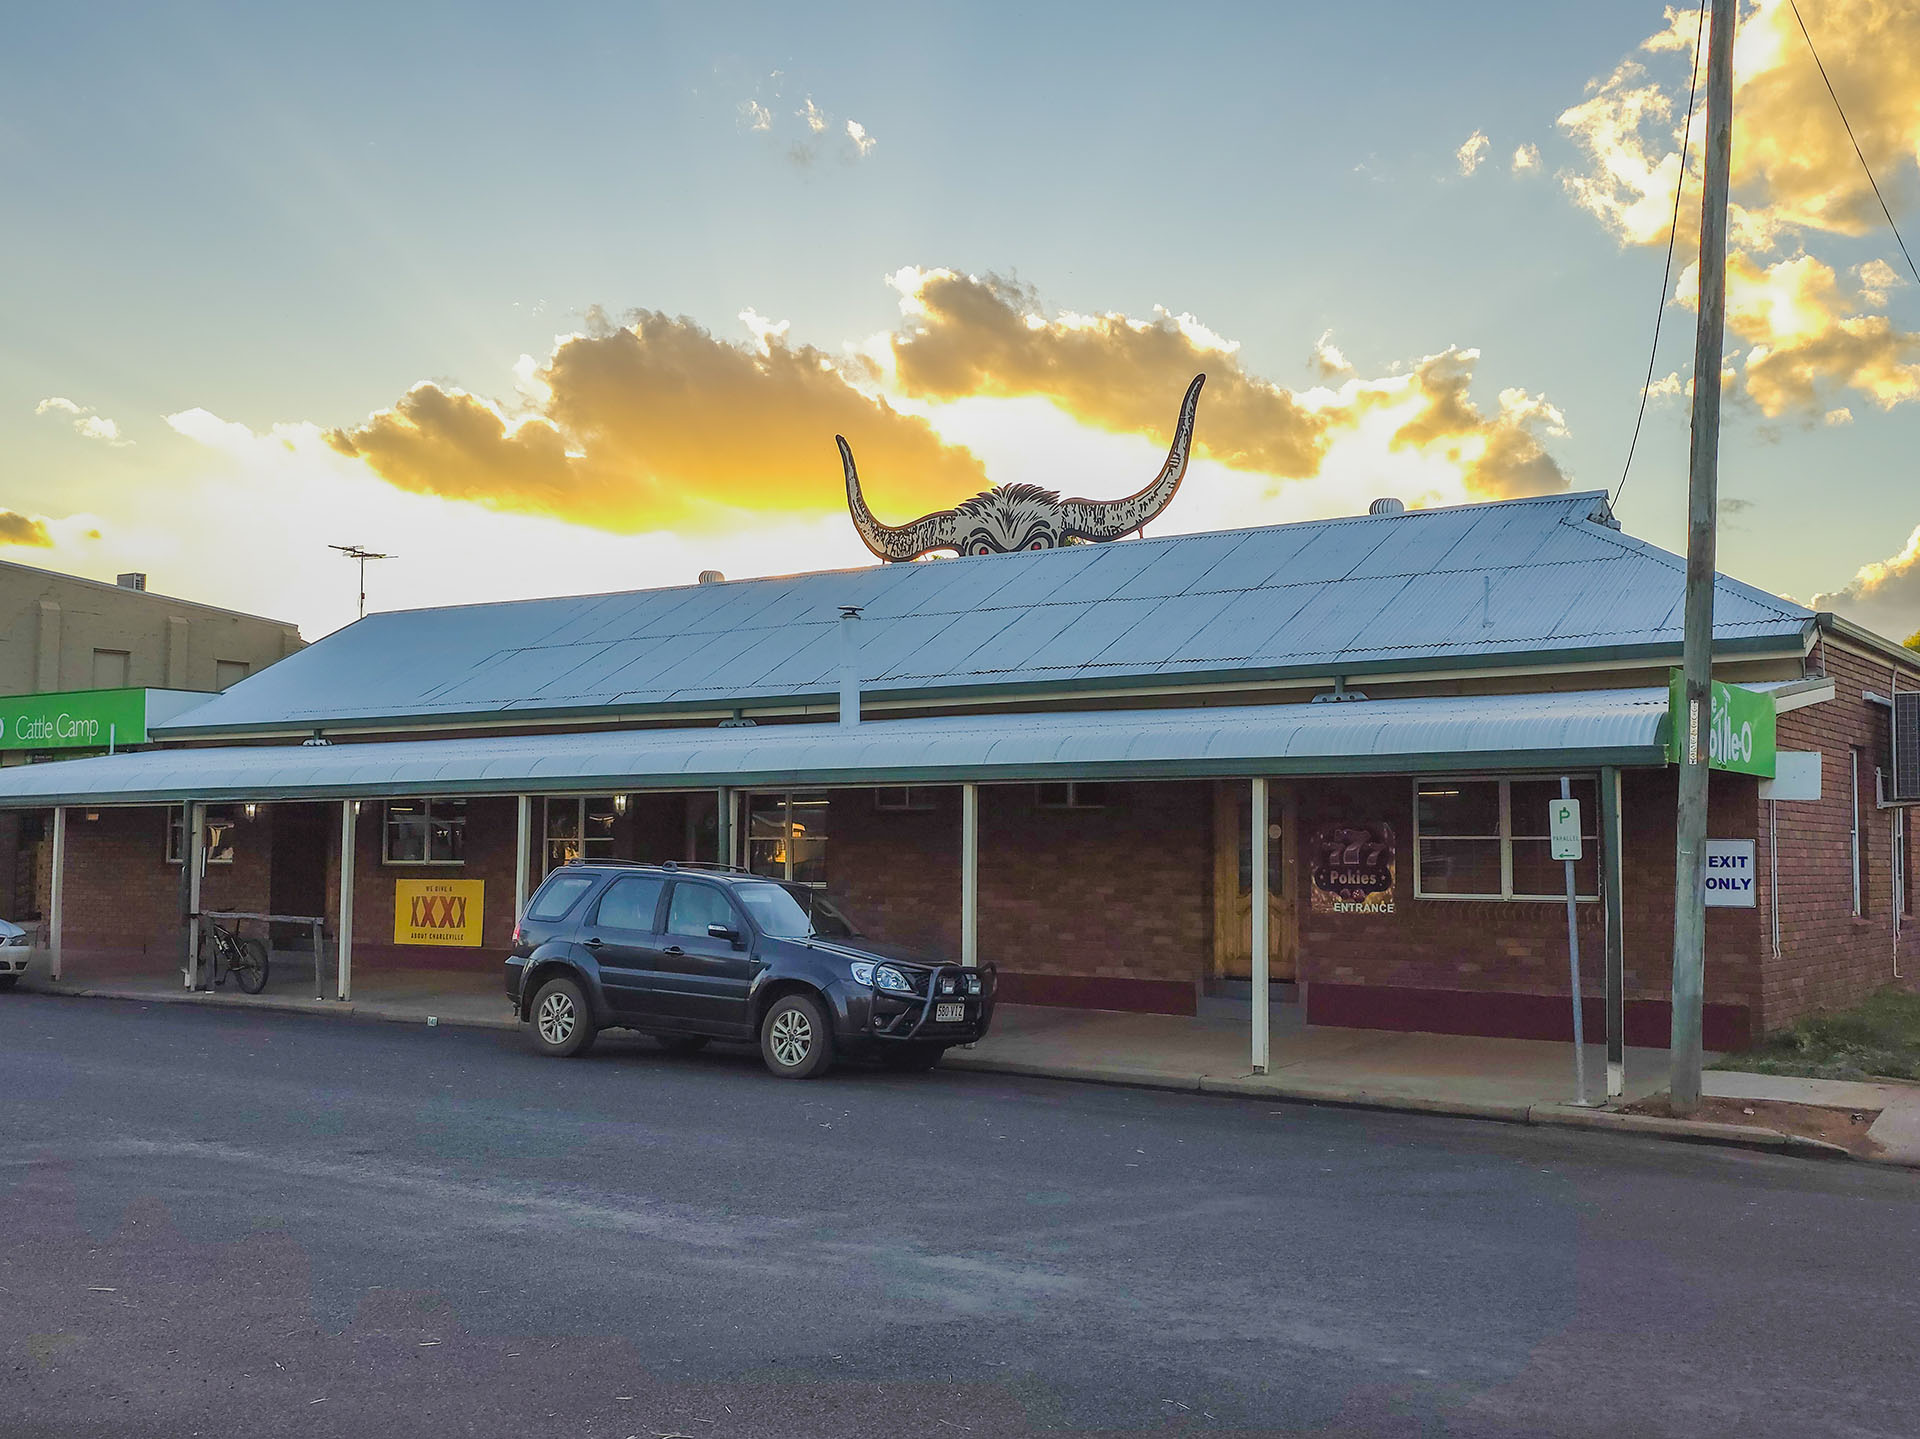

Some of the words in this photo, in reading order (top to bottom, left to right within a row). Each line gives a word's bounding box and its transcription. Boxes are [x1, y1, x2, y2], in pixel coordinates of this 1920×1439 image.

[15, 715, 54, 740] Cattle
[56, 713, 99, 745] Camp
[1708, 855, 1749, 868] EXIT
[1330, 869, 1377, 885] Pokies
[1705, 877, 1752, 890] ONLY
[410, 895, 467, 928] XXXX
[1333, 902, 1395, 913] ENTRANCE
[429, 933, 464, 941] CHARLEVILLE
